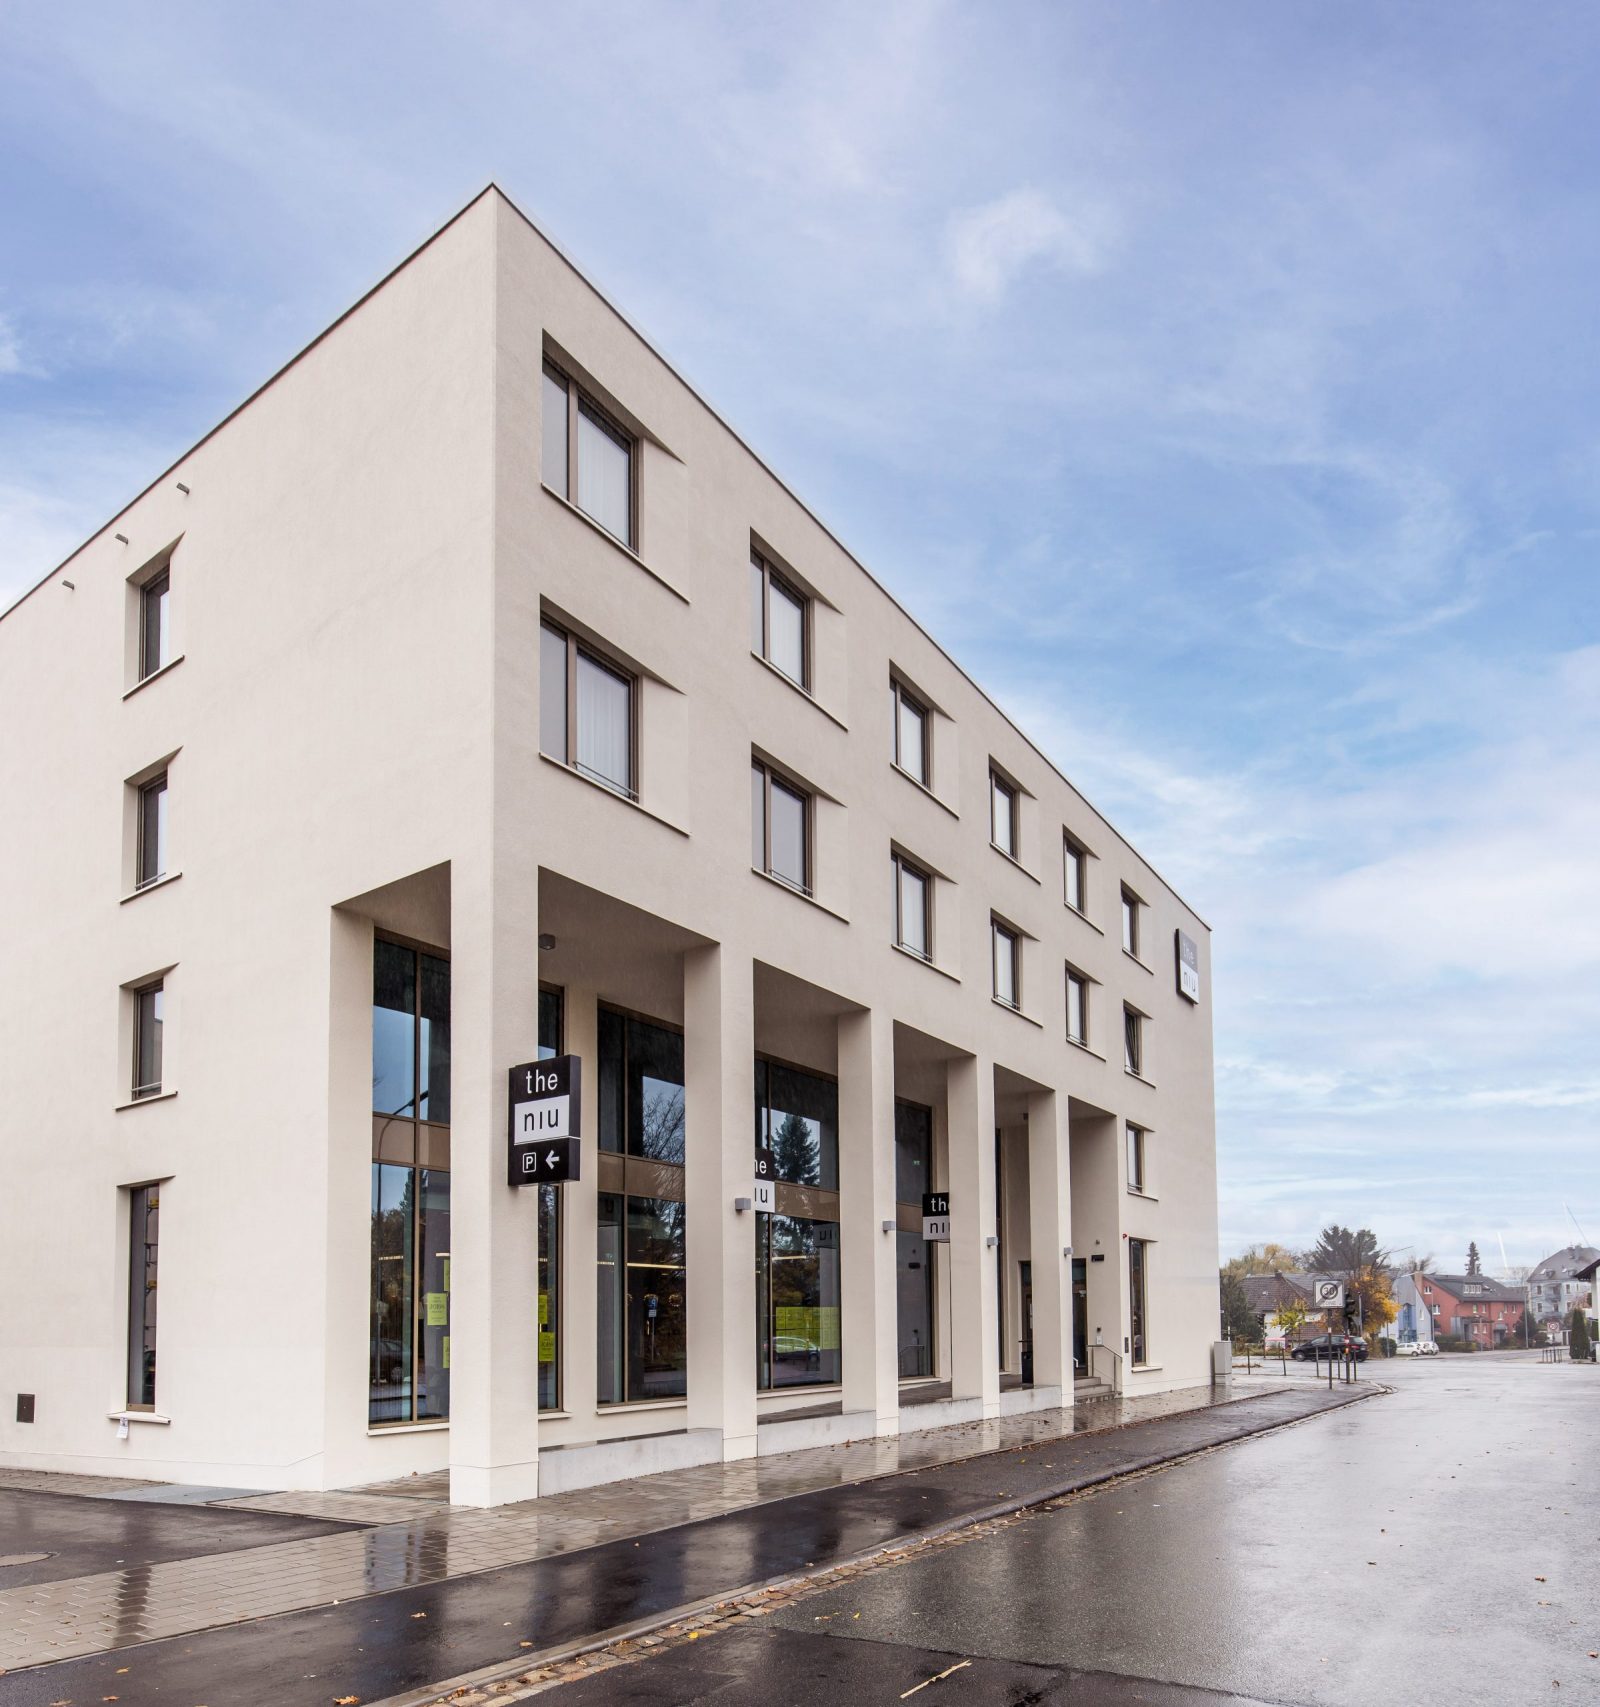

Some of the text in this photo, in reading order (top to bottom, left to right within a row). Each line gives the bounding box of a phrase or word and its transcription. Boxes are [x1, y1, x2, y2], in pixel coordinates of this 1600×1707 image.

[526, 1069, 558, 1094] the
[524, 1109, 559, 1132] niu
[931, 1197, 950, 1212] th
[930, 1222, 950, 1234] ni
[1323, 1287, 1334, 1295] 30
